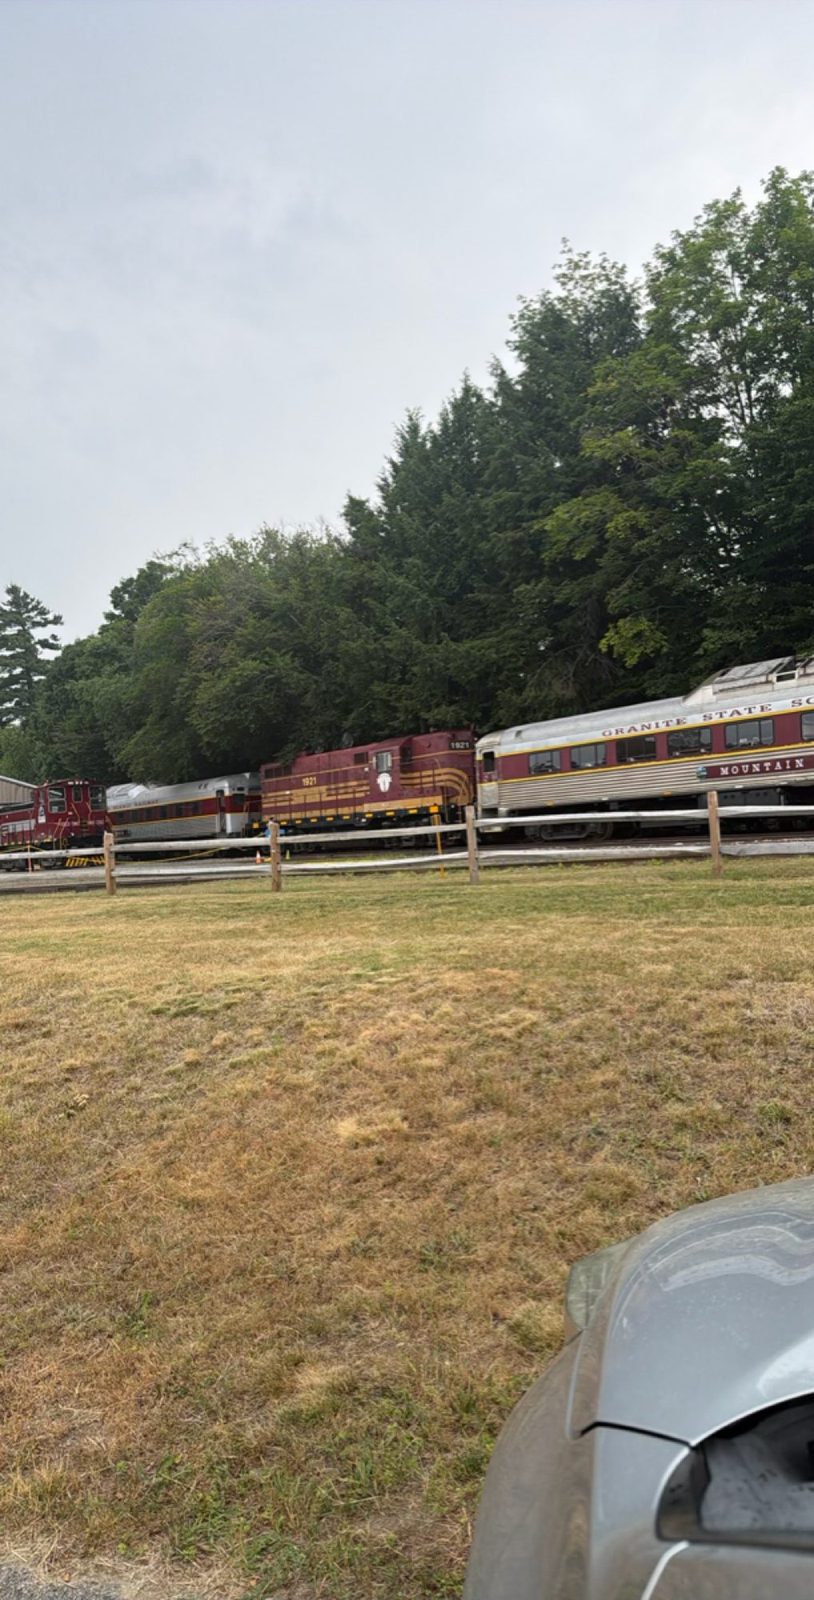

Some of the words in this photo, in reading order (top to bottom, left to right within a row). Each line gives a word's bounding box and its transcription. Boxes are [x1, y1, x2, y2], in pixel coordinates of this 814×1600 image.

[601, 717, 687, 737] GRANITE
[703, 704, 772, 721] STATE
[450, 741, 470, 749] 1921
[719, 758, 804, 776] MOUNTAIN
[302, 776, 317, 786] 1921
